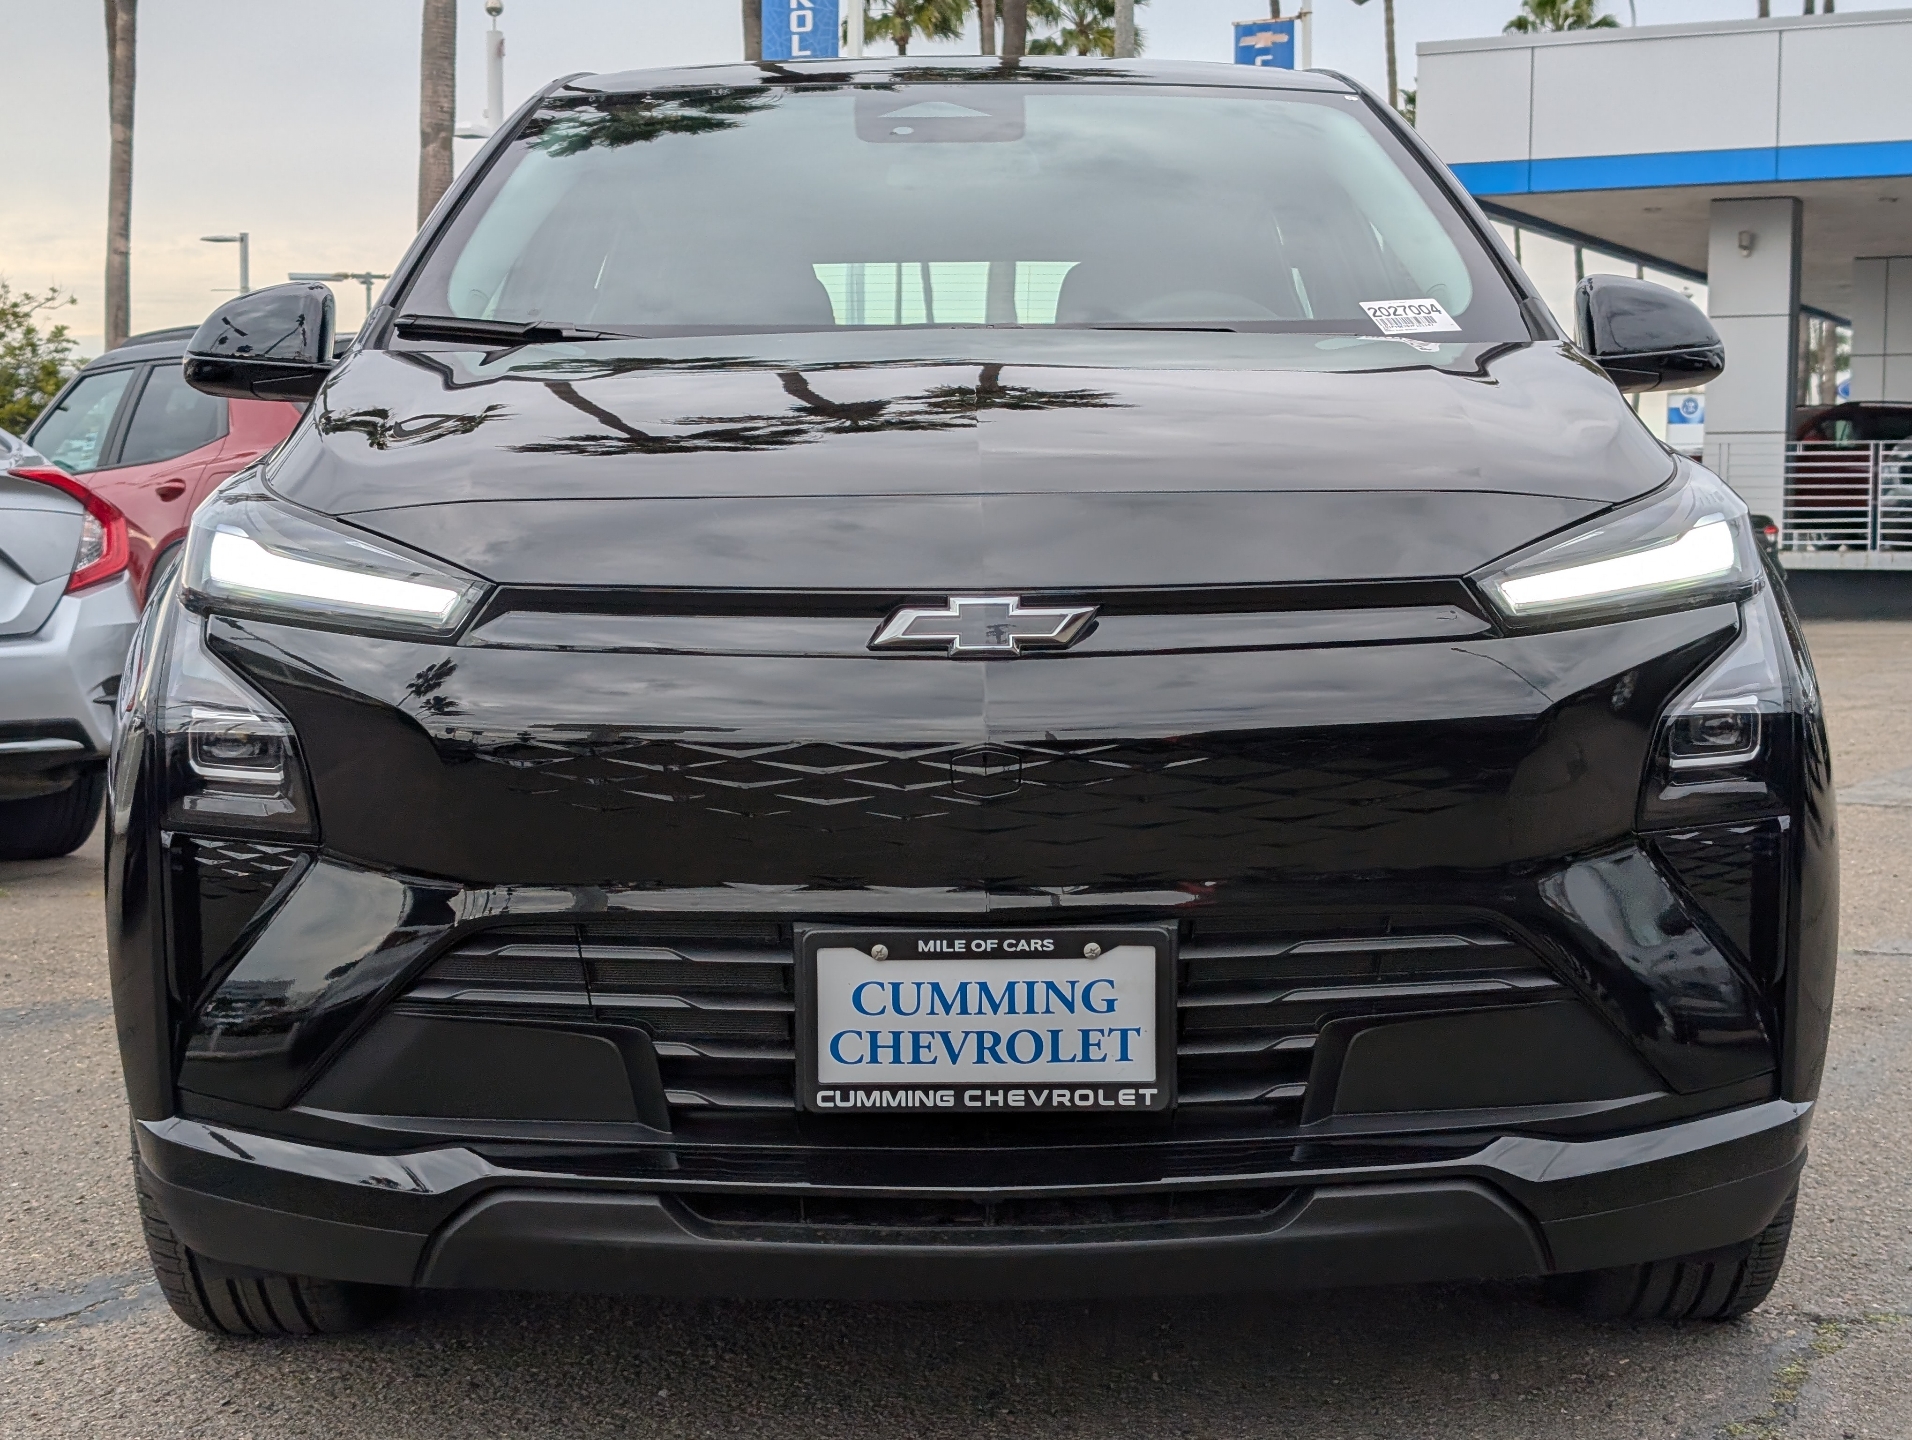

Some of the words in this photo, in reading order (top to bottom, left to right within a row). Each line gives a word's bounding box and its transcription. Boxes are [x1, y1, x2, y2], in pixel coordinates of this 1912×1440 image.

[1367, 304, 1442, 317] 2027004
[918, 940, 966, 952] MILE
[970, 939, 998, 952] OF
[1002, 939, 1054, 952] CARS
[851, 979, 1118, 1016] CUMMING
[830, 1027, 1141, 1065] CHEVROLET
[816, 1090, 955, 1108] CUMMING
[963, 1088, 1158, 1107] CHEVROLET
